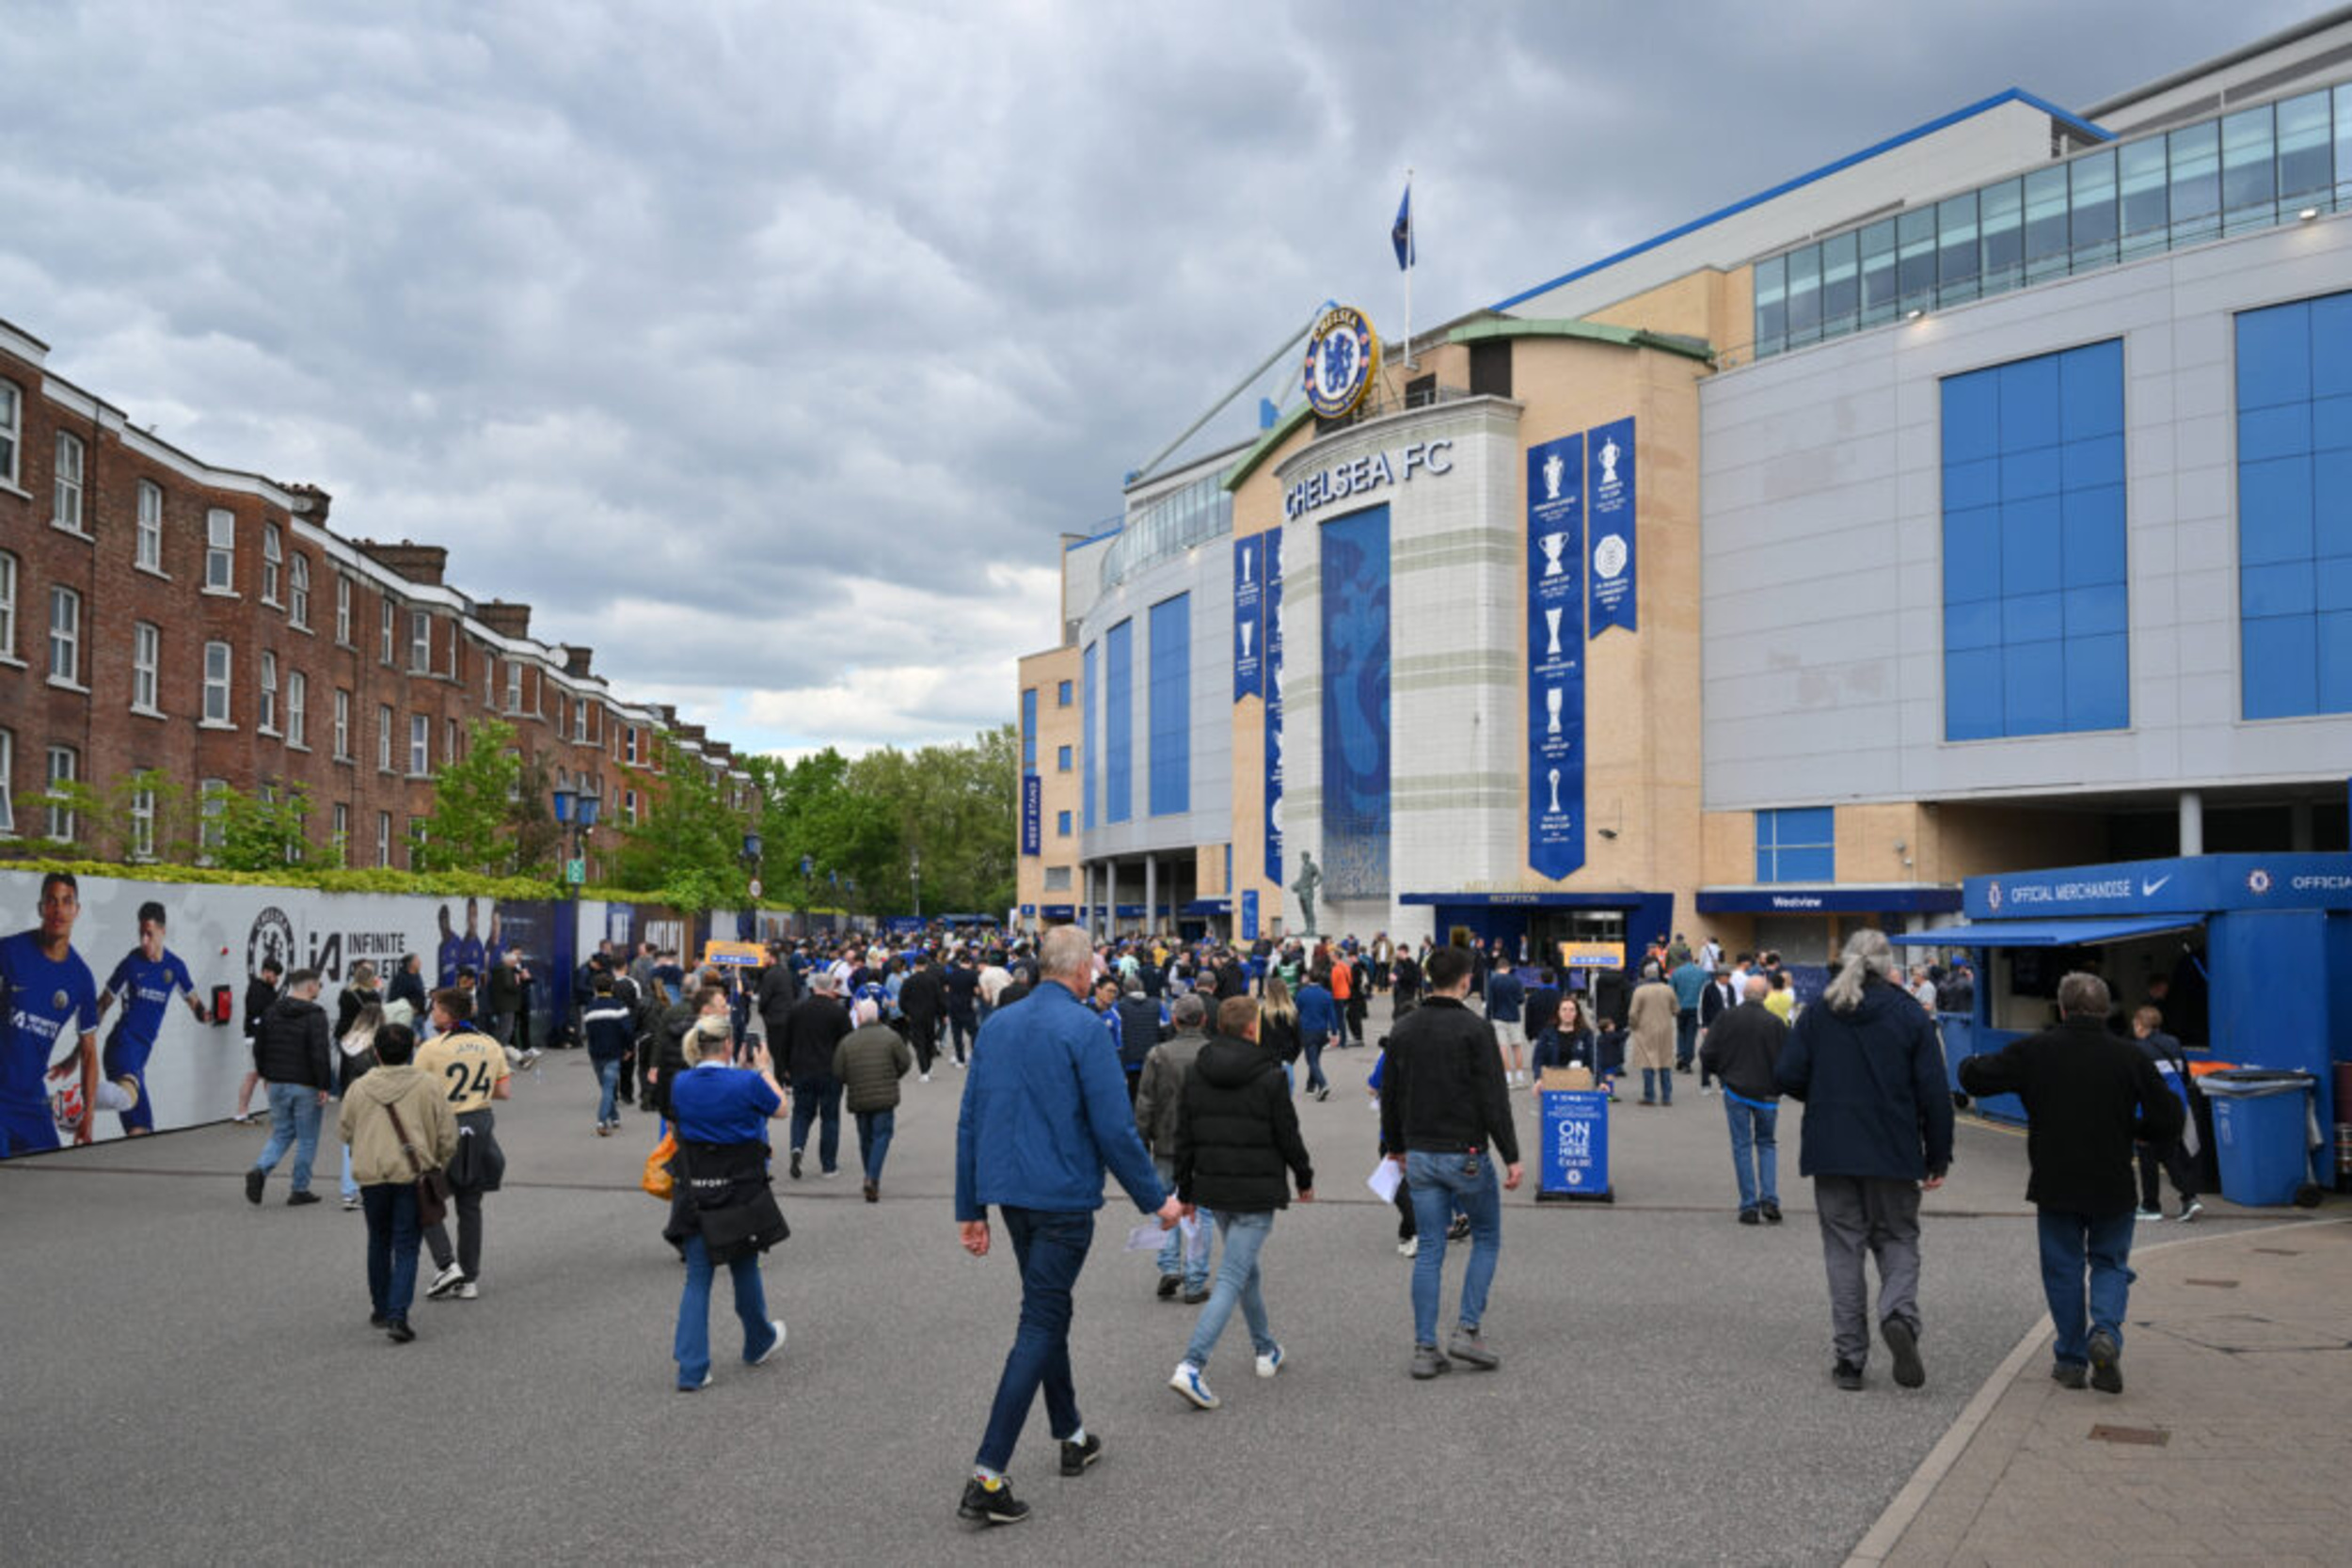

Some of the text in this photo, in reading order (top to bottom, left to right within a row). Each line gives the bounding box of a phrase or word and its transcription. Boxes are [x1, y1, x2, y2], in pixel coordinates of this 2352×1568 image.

[1286, 439, 1453, 521] CHELSEA FC
[1488, 894, 1540, 904] RECEPTION
[2010, 879, 2132, 903] OFFICIAL MERCHANDISE
[347, 932, 405, 955] INFINITE
[445, 1060, 491, 1102] 24
[1559, 1120, 1590, 1137] ON
